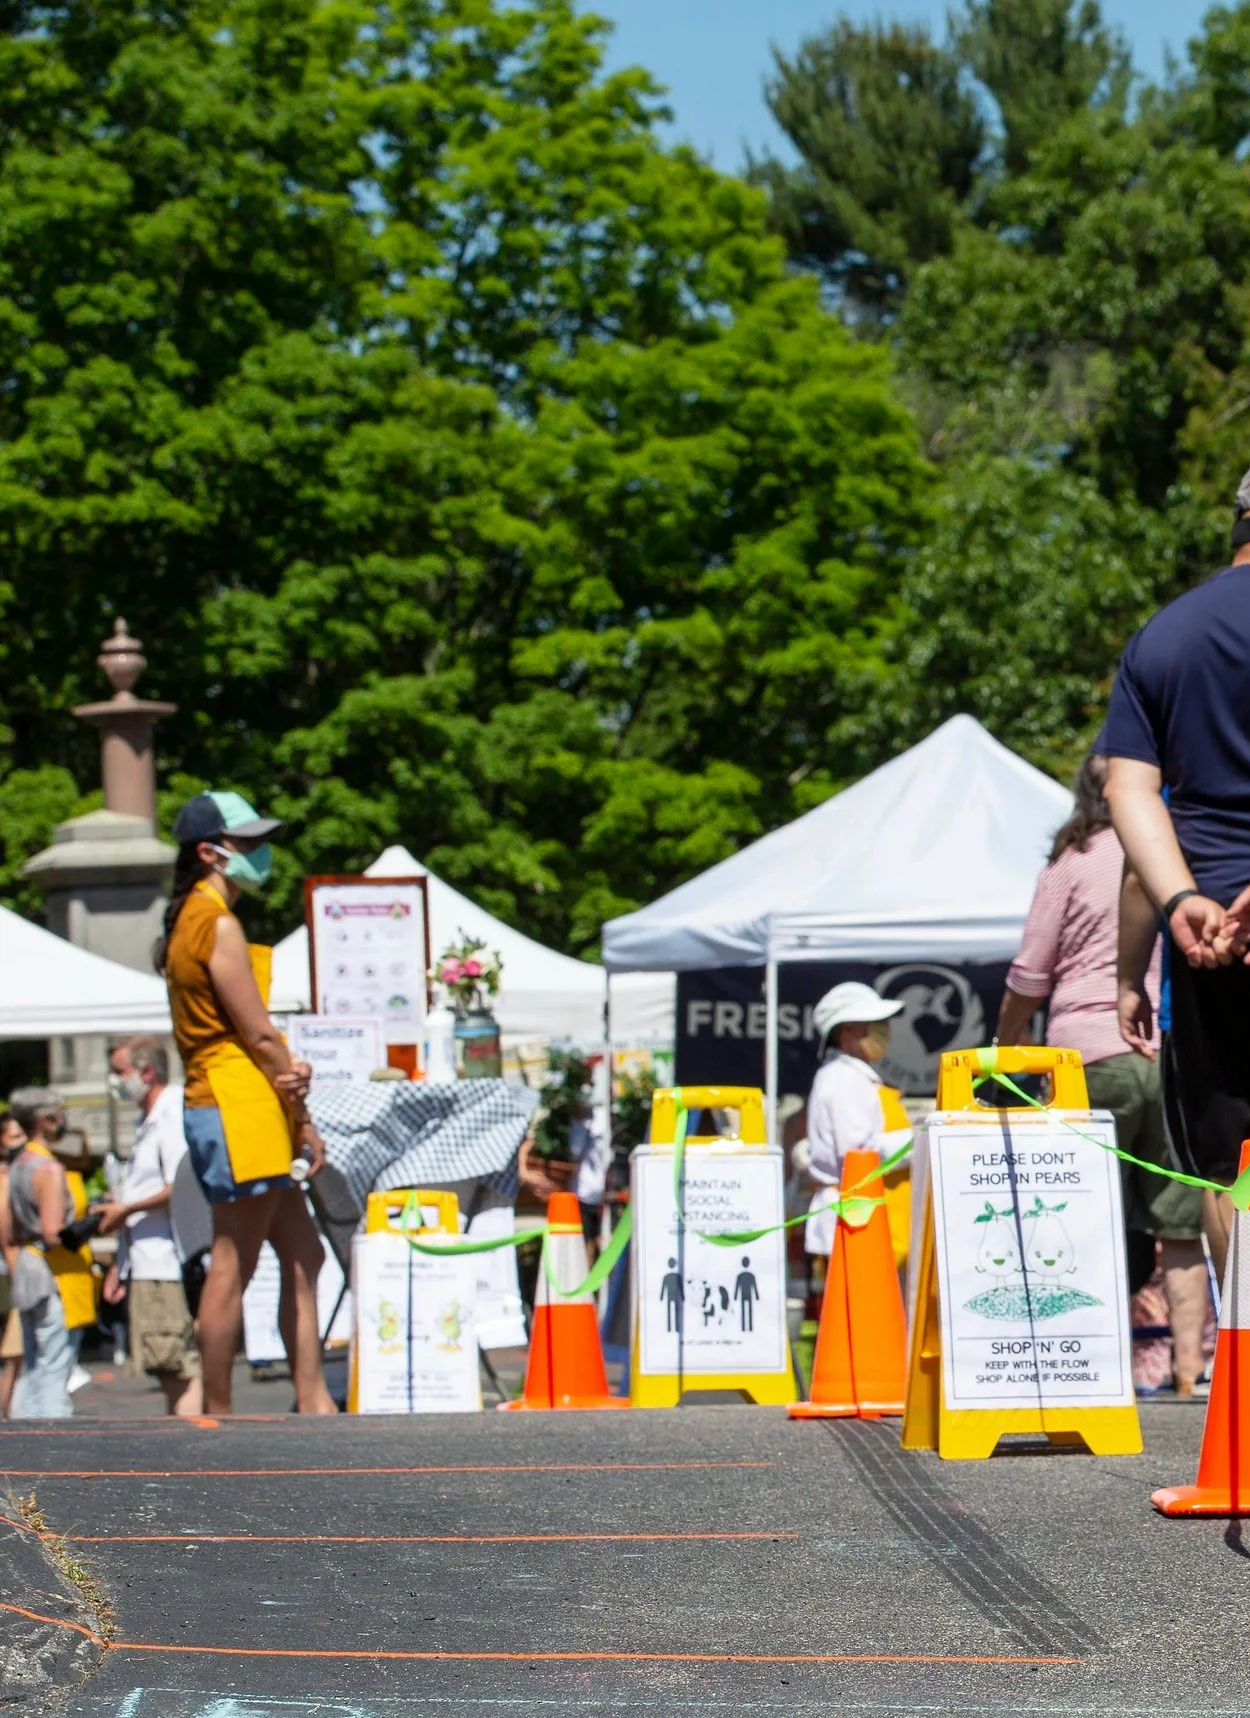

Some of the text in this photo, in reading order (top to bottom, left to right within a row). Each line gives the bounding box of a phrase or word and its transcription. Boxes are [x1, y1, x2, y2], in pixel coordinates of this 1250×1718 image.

[315, 1067, 353, 1080] ands
[972, 1152, 1076, 1166] PLEASE DON'T
[970, 1171, 1081, 1186] SHOP IN PEARS
[688, 1195, 732, 1206] SOCIAL
[991, 1341, 1032, 1355] SHOP
[1060, 1340, 1081, 1353] GO
[985, 1359, 1090, 1370] KEEP WITH THE FLOW
[975, 1372, 1100, 1384] SHOP ALONE IF POSSIBLE
